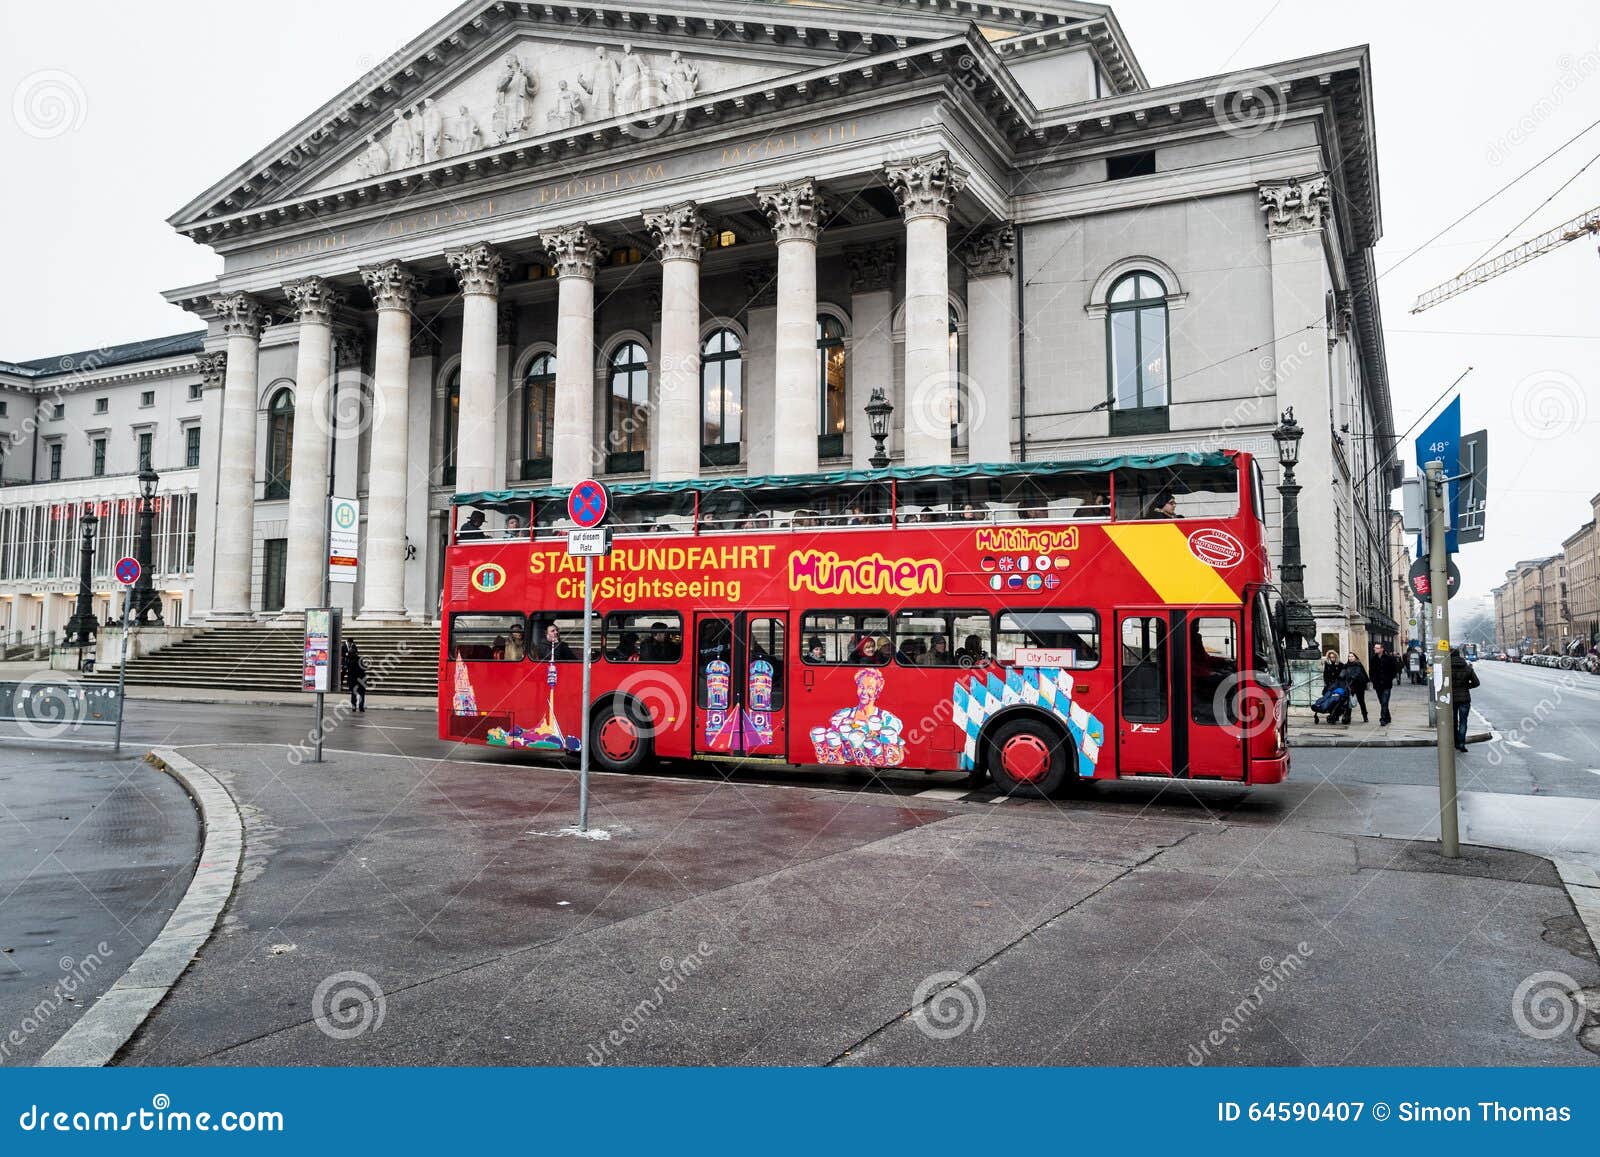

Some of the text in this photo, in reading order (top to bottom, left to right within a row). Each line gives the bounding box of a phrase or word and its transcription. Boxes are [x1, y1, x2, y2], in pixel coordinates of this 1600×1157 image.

[976, 526, 1079, 554] Multilingual
[789, 550, 942, 595] München
[1027, 653, 1061, 662] City Tour
